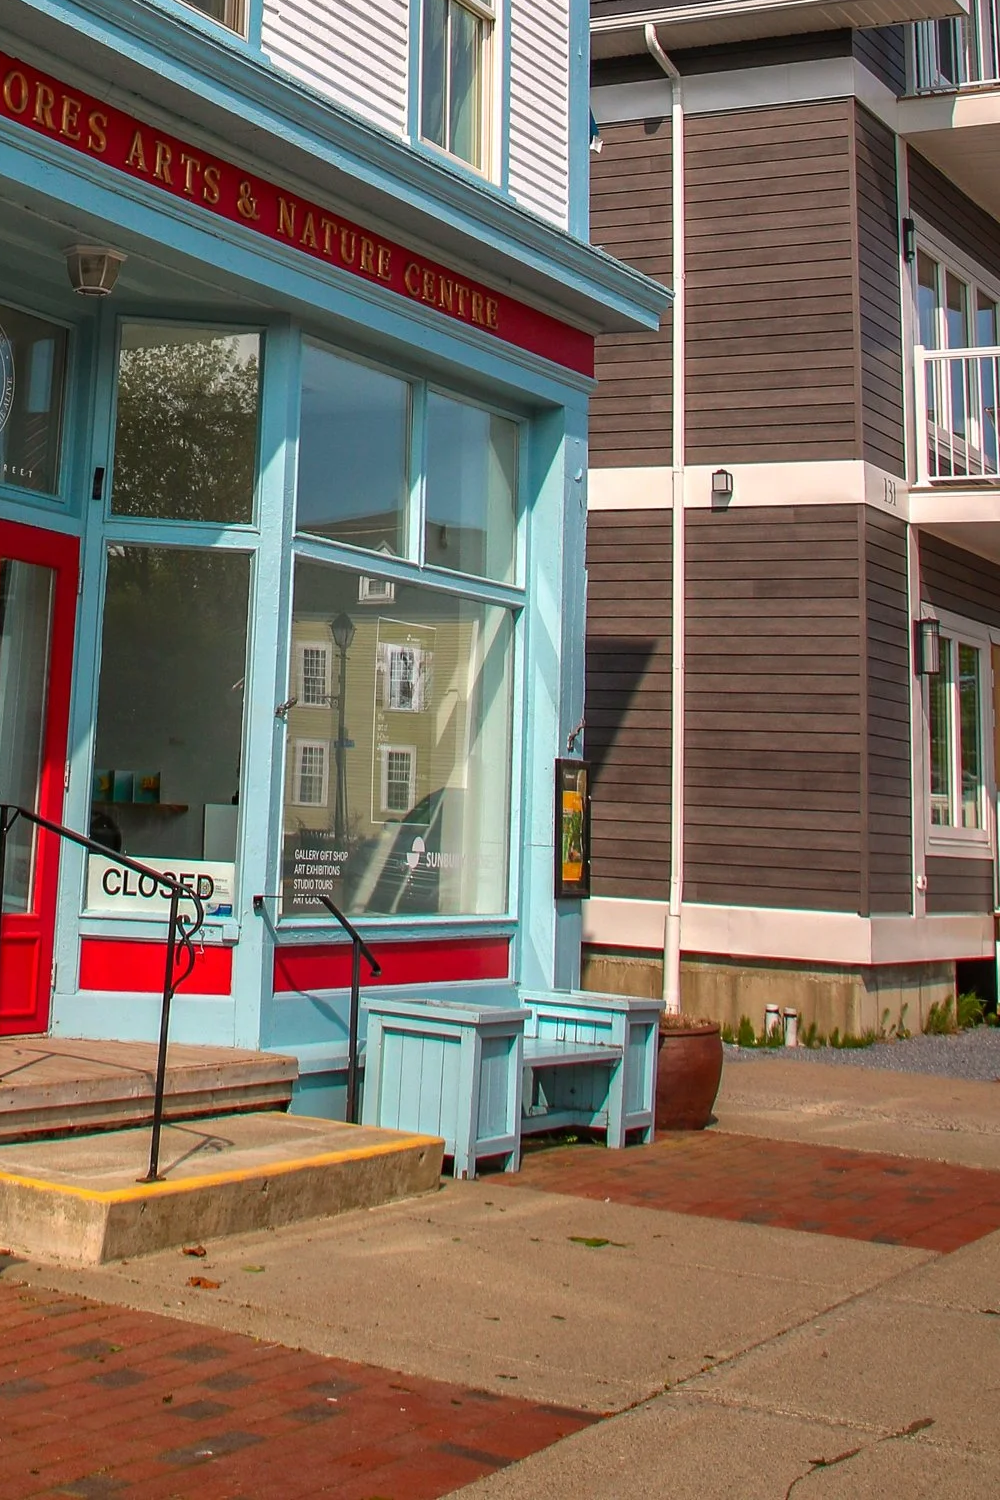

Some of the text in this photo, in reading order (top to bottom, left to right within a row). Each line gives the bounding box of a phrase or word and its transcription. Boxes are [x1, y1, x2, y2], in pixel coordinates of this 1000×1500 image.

[125, 129, 221, 204] ARTS
[237, 181, 260, 220] &
[277, 197, 392, 281] NATURE
[404, 263, 499, 330] CENTRE
[3, 376, 13, 410] ALIVE
[883, 477, 897, 507] 131
[294, 849, 349, 861] GALLERY GIFT SHOP
[294, 864, 340, 876] ART EXHIBITIONS
[102, 867, 214, 900] CLOSED
[293, 879, 333, 890] STUDIO TOURS
